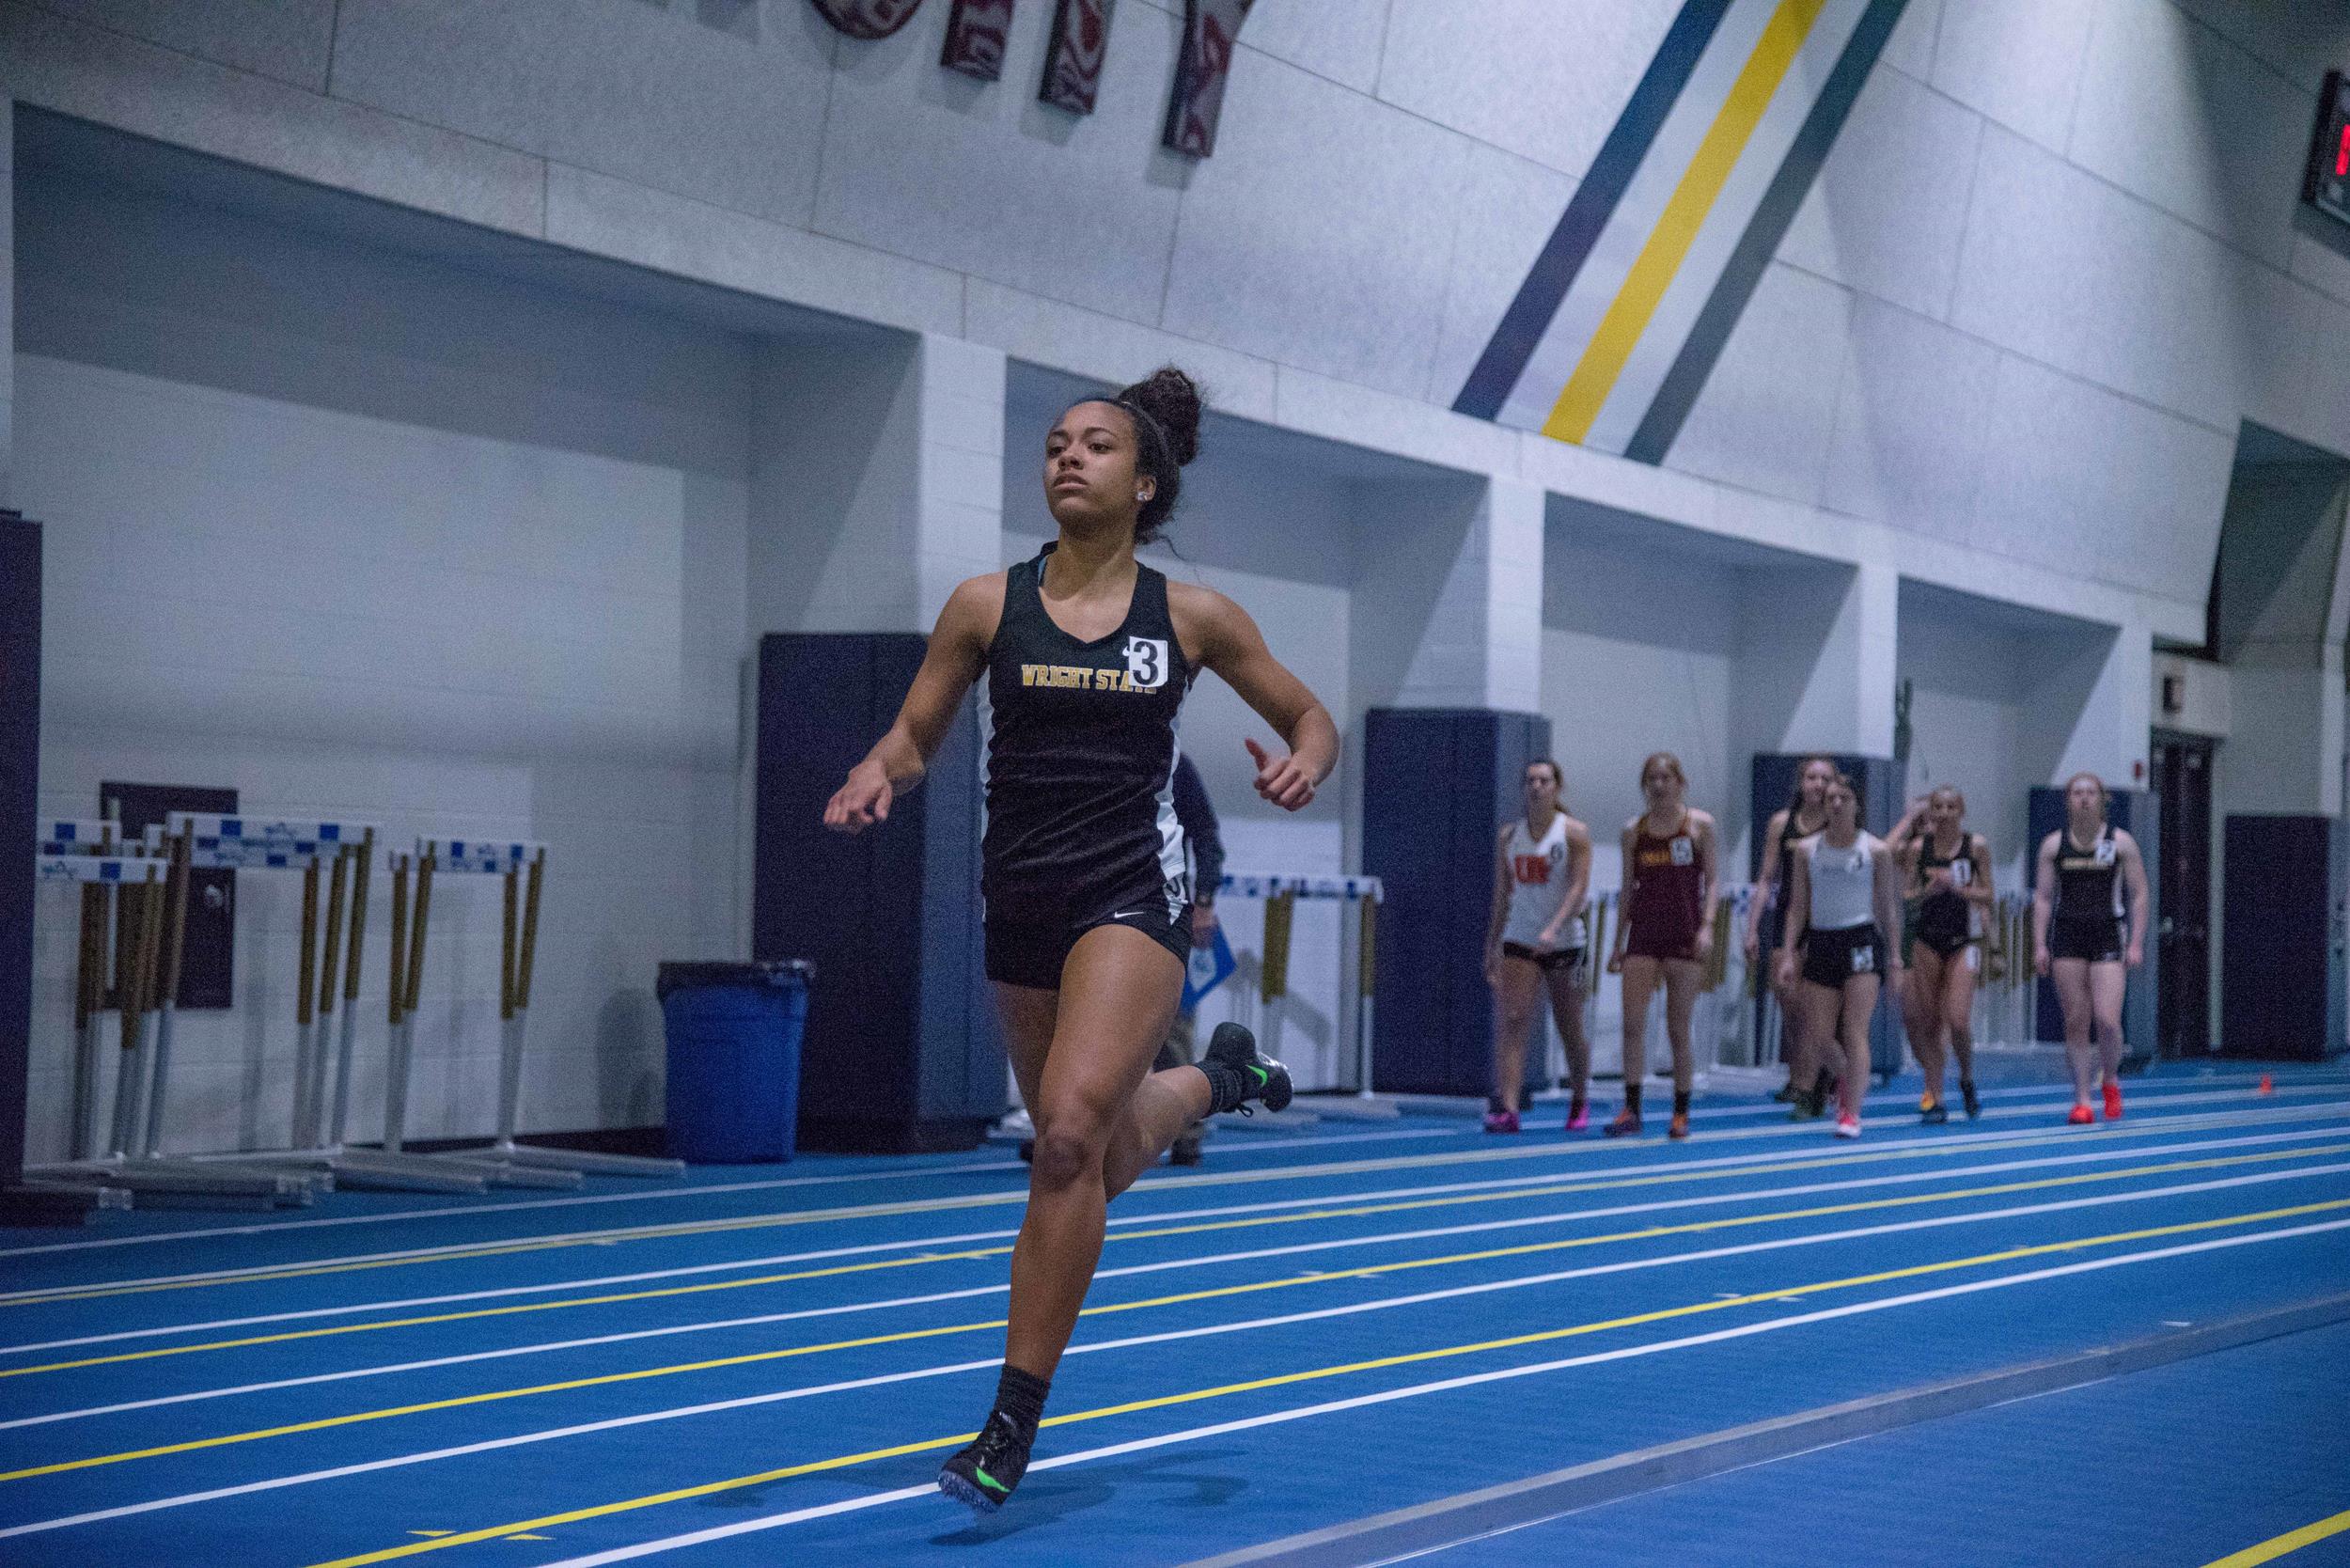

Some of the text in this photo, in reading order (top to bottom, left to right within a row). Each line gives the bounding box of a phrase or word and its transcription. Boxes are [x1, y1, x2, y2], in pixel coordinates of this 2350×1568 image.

[1021, 664, 1157, 695] WRIGHT STA
[1133, 640, 1159, 685] 3
